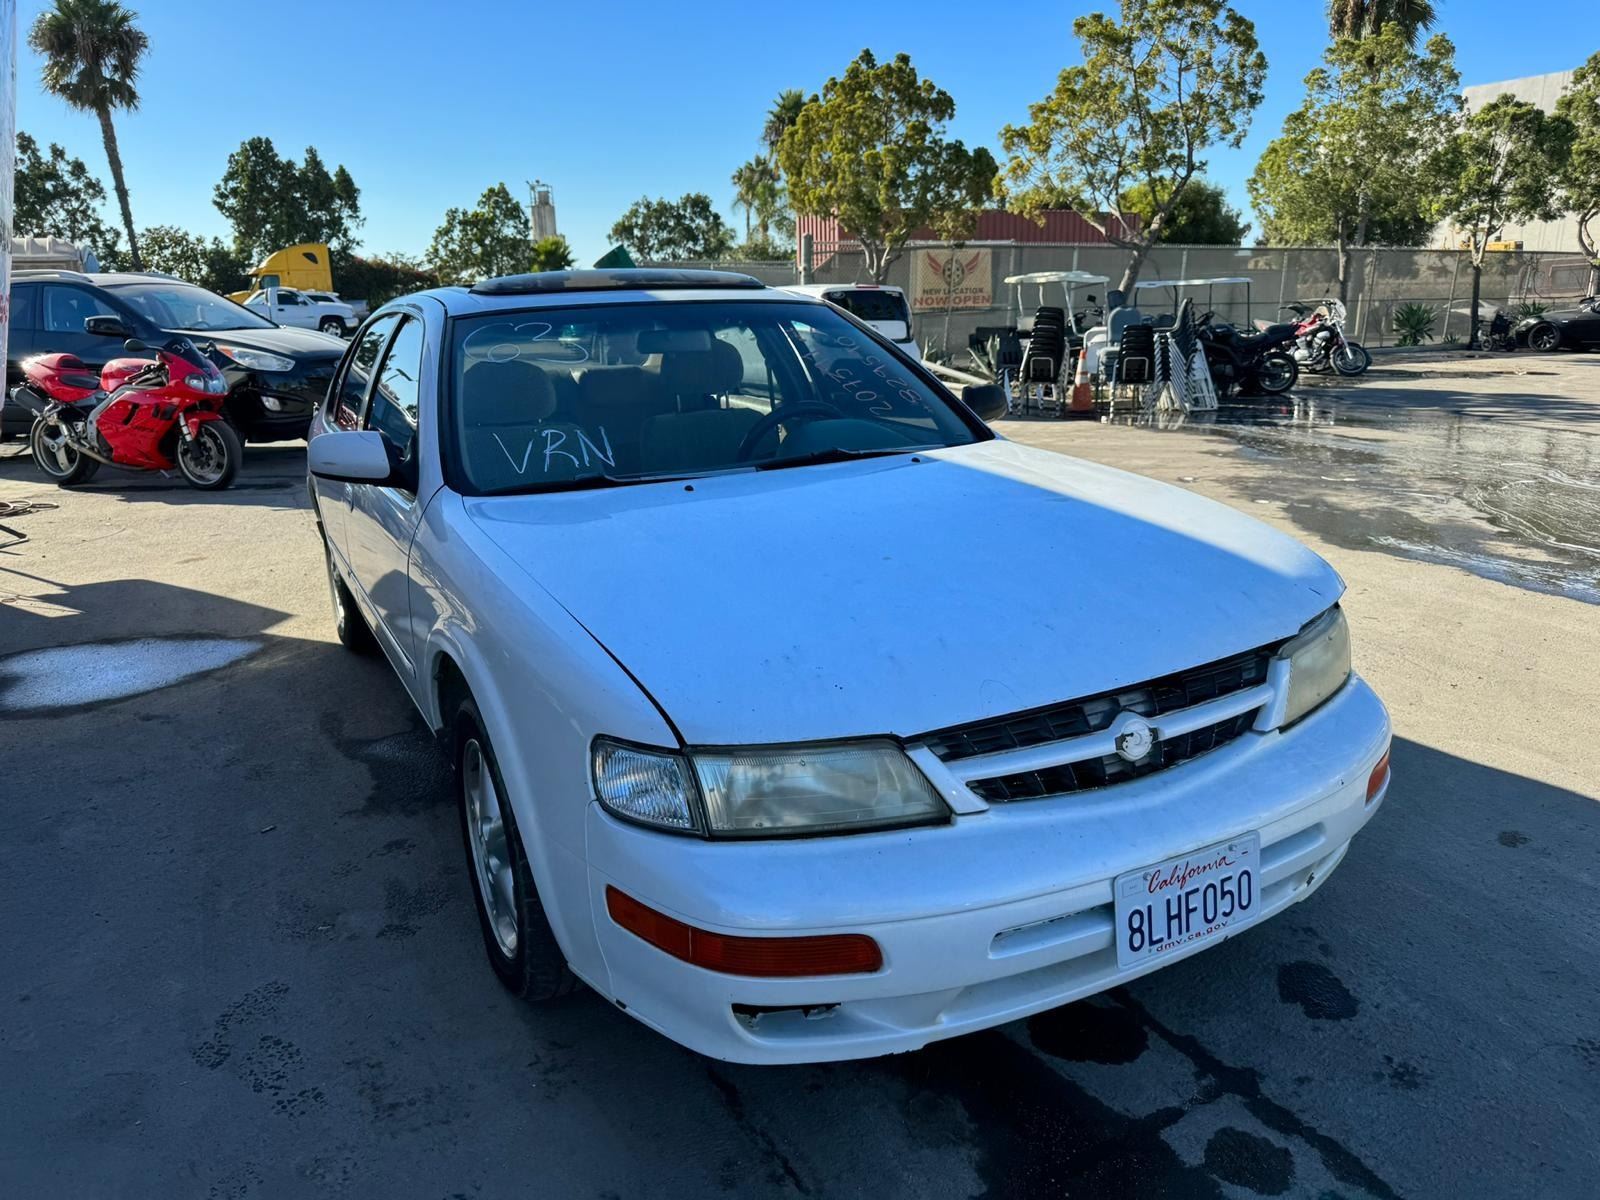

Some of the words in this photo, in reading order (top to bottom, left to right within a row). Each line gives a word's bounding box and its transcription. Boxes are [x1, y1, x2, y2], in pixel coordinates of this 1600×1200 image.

[914, 296, 949, 306] NOW
[953, 294, 991, 305] OPEN
[922, 288, 941, 296] NEW
[493, 426, 615, 474] VRN
[1147, 851, 1236, 893] California
[1128, 869, 1252, 952] 8LHF050
[1156, 920, 1228, 952] dmv.ca.gov
